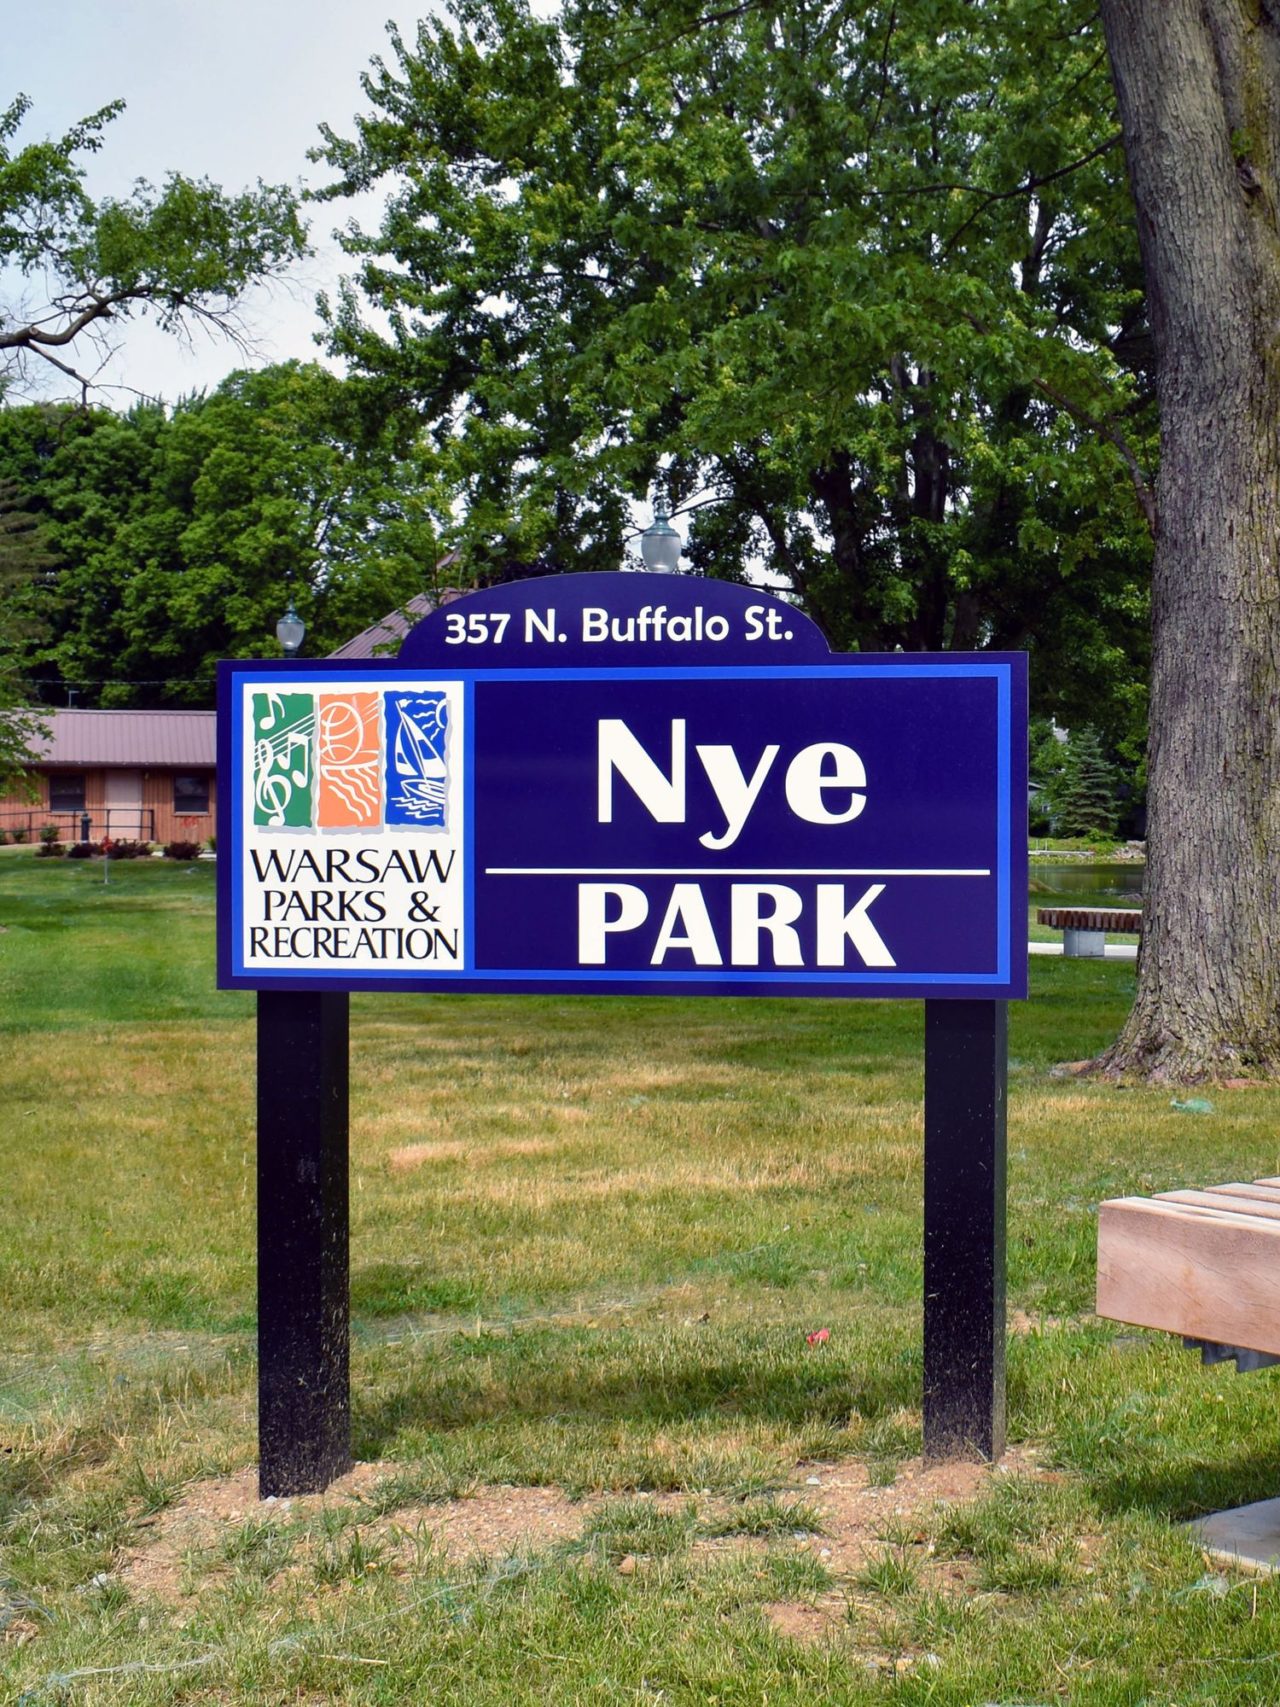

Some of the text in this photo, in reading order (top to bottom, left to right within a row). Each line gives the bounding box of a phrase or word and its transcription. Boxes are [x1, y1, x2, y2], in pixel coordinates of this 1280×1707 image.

[444, 604, 794, 645] 357 N. Buffalo St.
[597, 718, 867, 850] Nye
[249, 848, 456, 884] WARSAW
[263, 890, 440, 923] PARKS &
[578, 882, 897, 967] PARK
[249, 926, 459, 961] RECREATION
